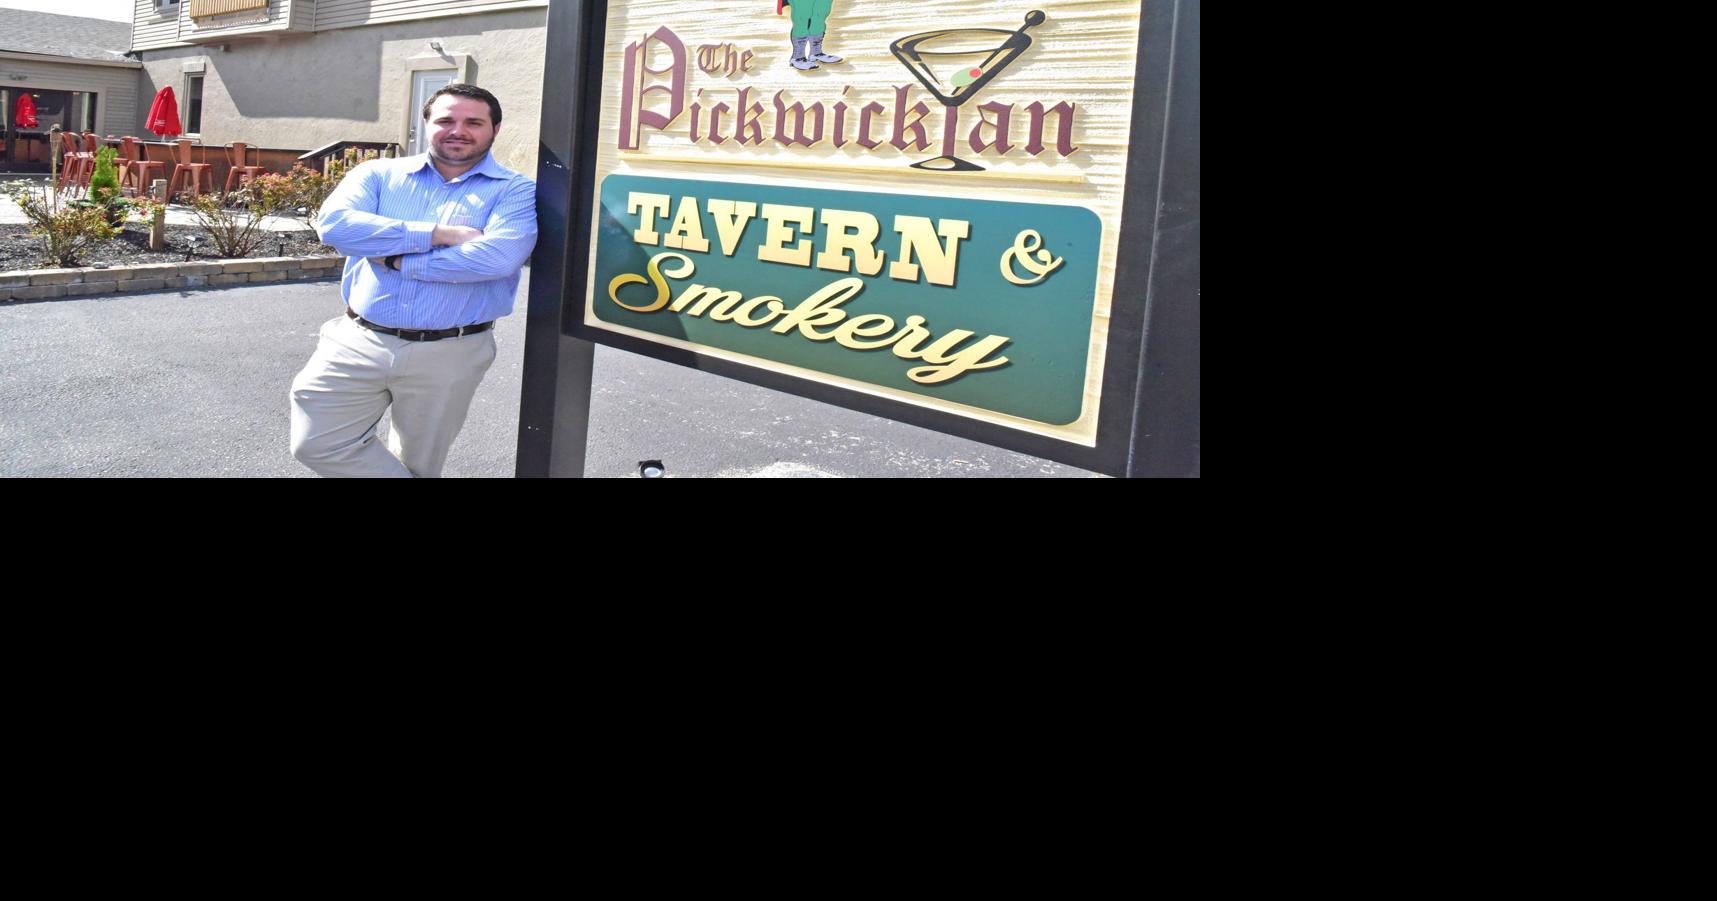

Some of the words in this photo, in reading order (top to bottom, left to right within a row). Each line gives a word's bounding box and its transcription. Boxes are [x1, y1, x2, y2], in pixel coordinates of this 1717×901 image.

[696, 42, 754, 75] The
[627, 191, 970, 287] TAVERN
[1000, 229, 1063, 285] &
[608, 252, 1010, 384] Smokery
